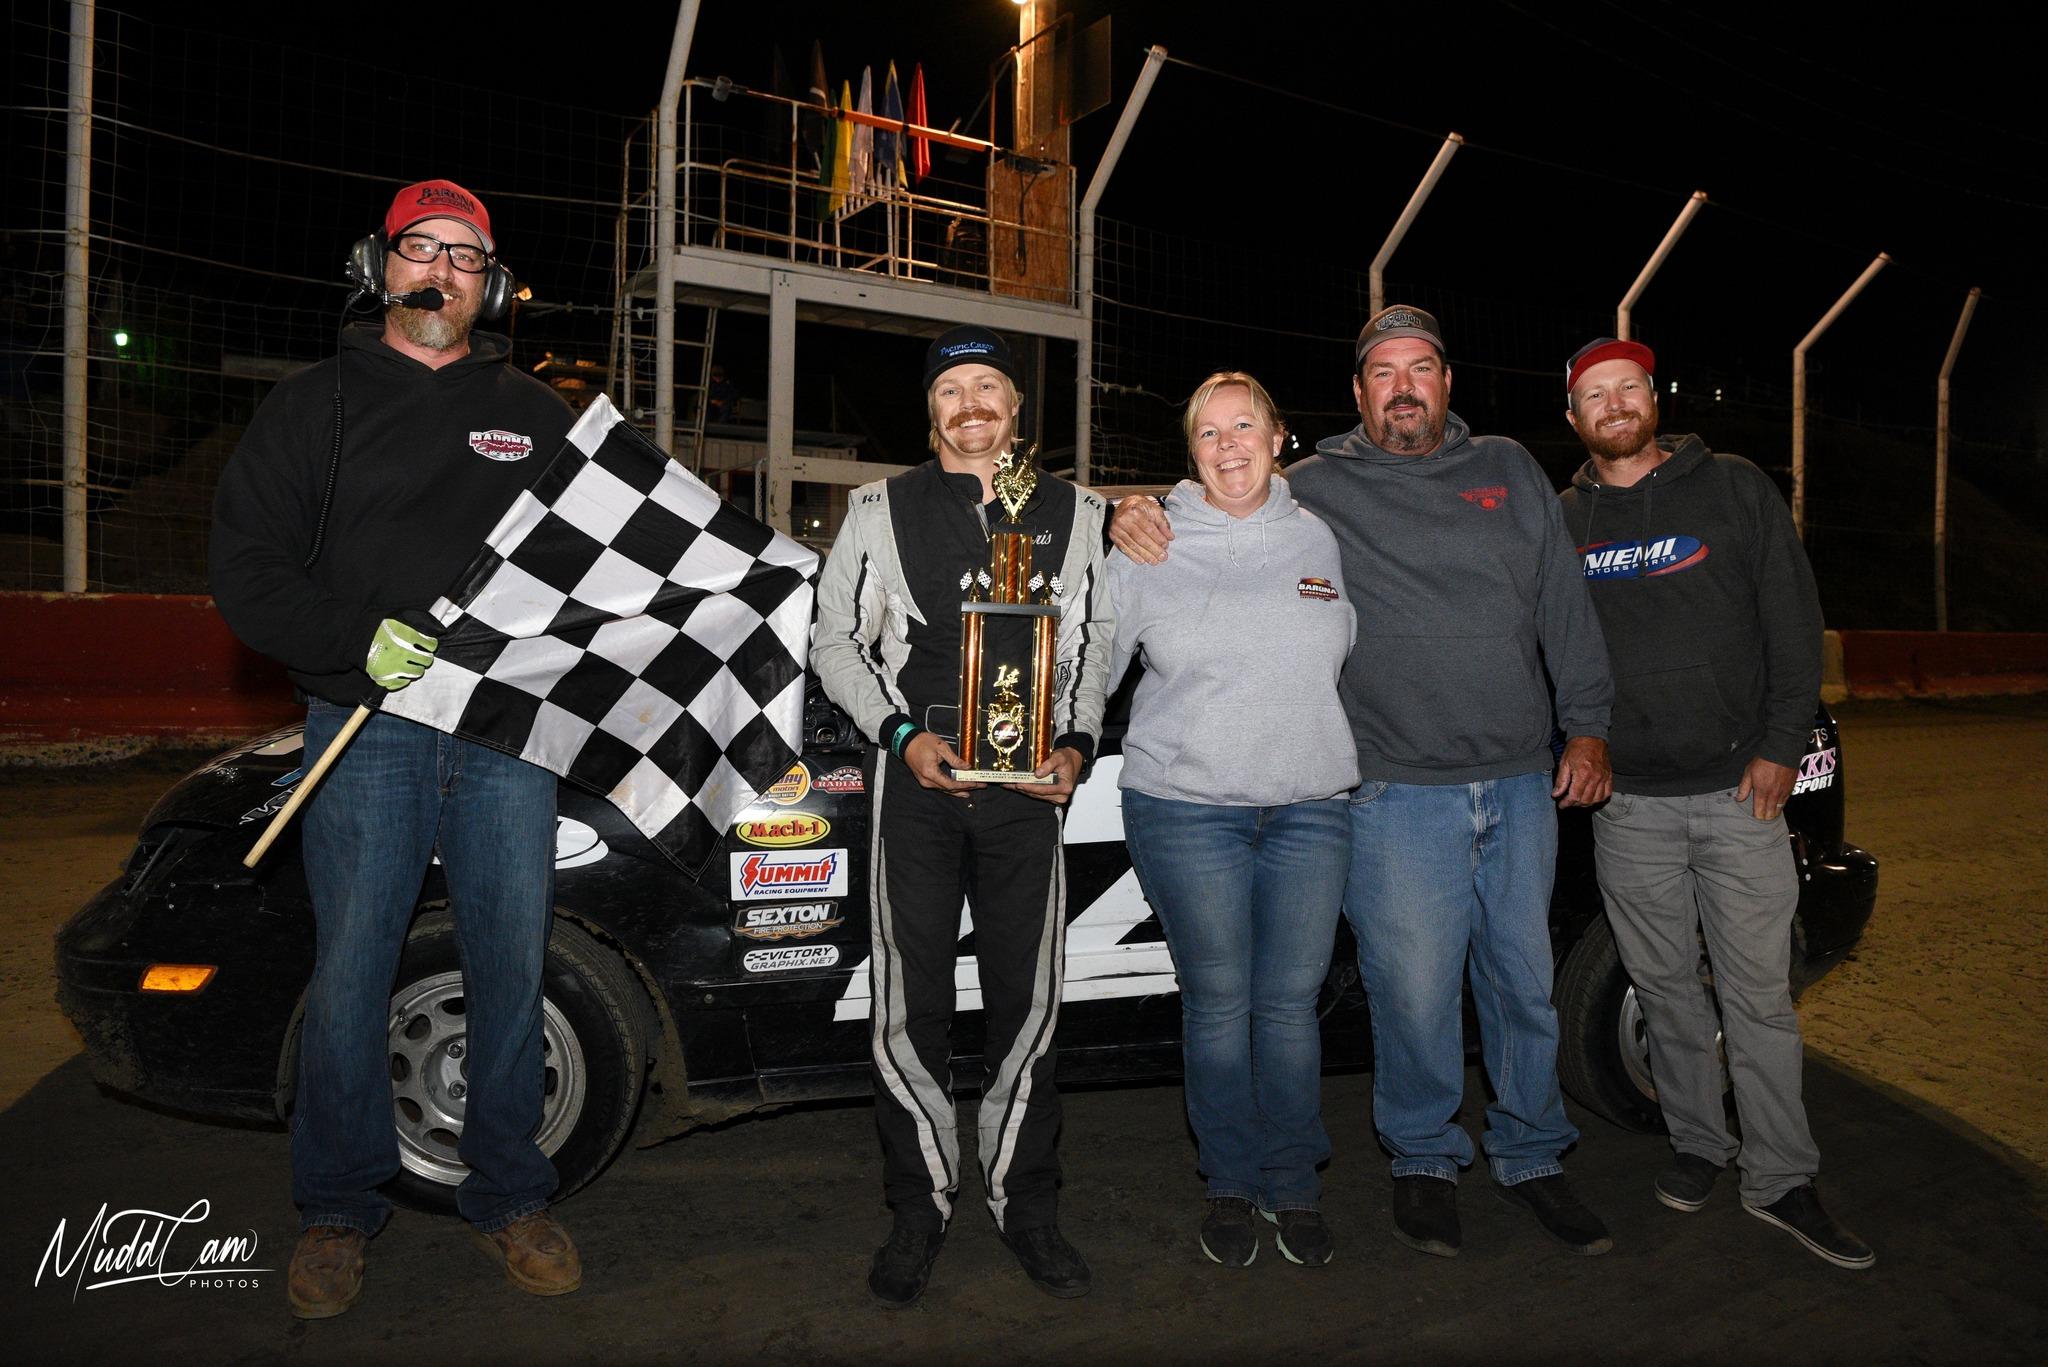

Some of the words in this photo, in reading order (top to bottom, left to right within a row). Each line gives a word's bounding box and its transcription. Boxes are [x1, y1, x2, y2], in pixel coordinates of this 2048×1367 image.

[1584, 538, 1677, 570] NIEMI
[1584, 556, 1677, 576] OTORSPRTS
[1792, 774, 1834, 795] SPORT
[748, 819, 821, 838] Mach-1
[745, 903, 830, 926] SEXTON
[754, 927, 772, 935] FIRE
[772, 922, 823, 933] PROTECTION
[768, 946, 830, 960] VICTORY
[751, 956, 835, 970] GRAPHIX.NET
